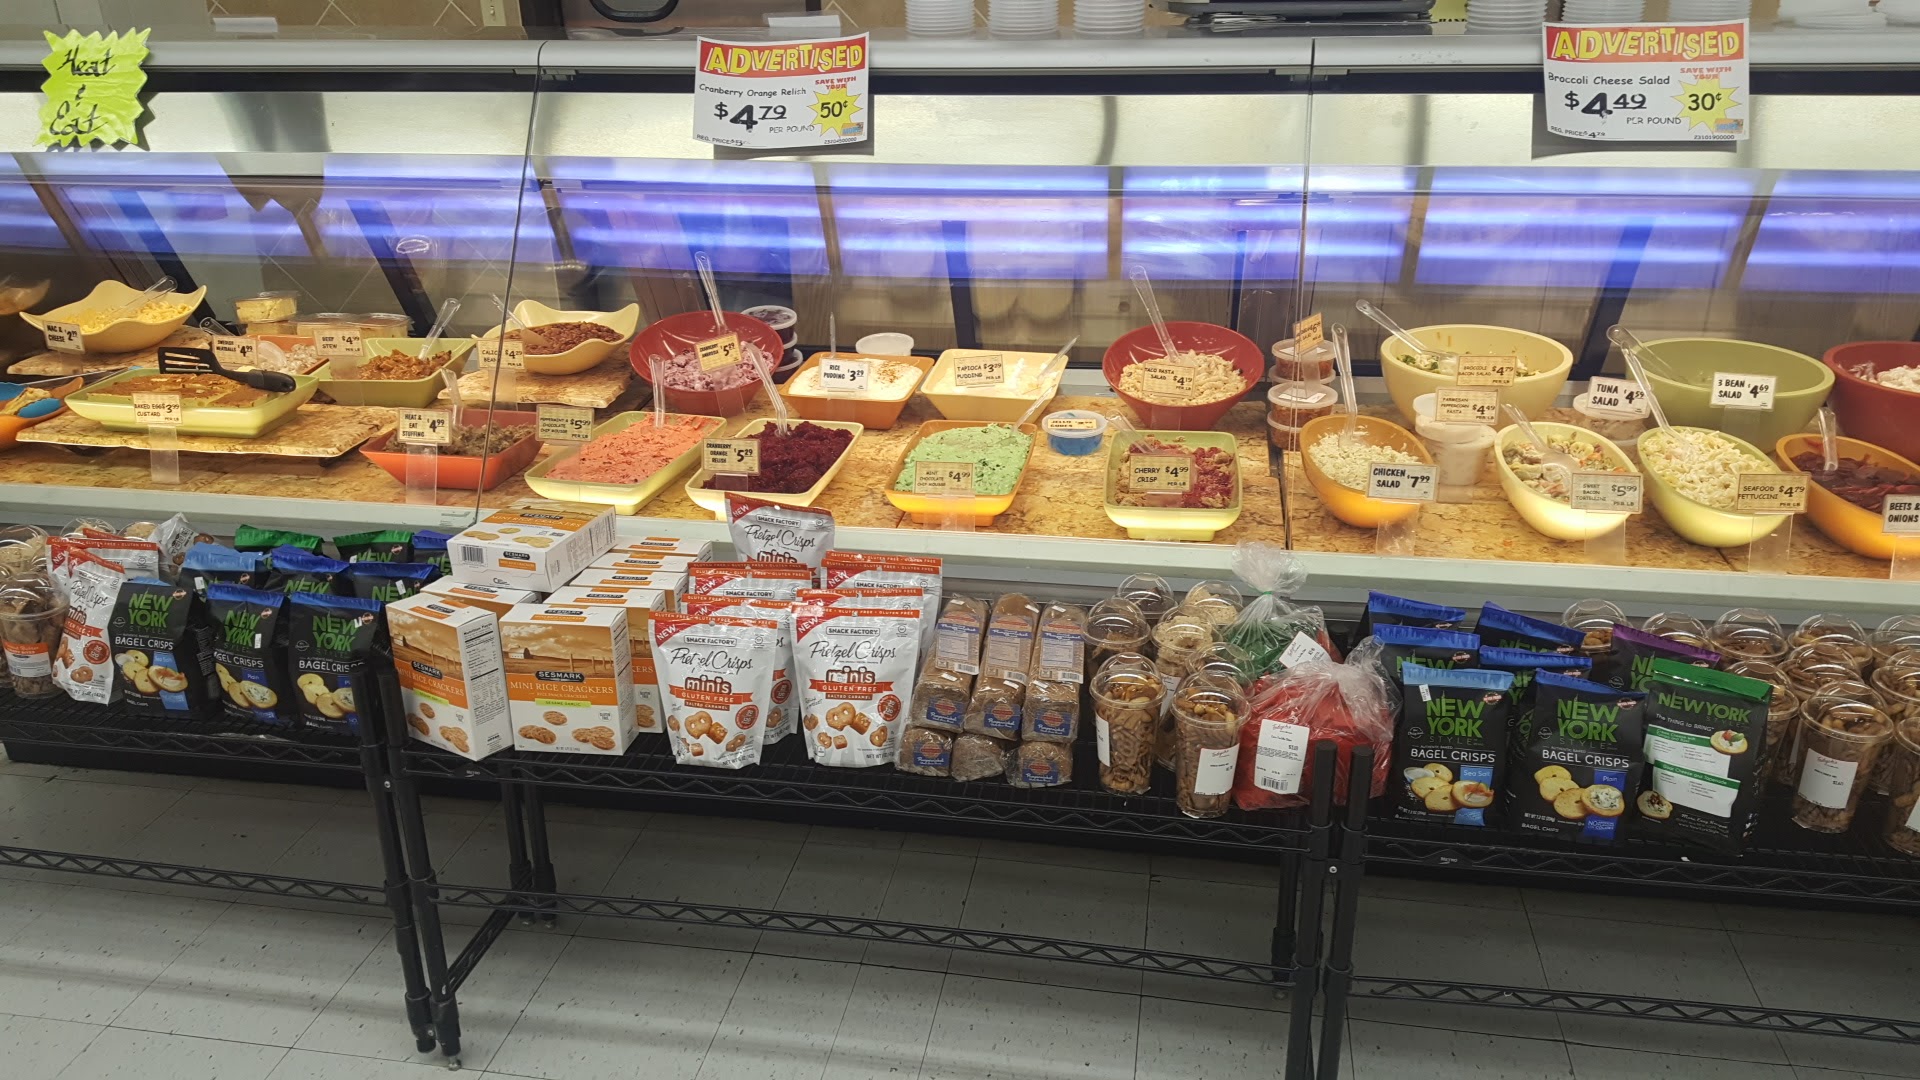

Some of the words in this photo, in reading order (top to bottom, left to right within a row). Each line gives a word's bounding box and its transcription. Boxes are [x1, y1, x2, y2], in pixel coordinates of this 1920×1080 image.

[1551, 27, 1740, 60] ADVERTISED
[57, 45, 118, 77] Heat
[705, 44, 864, 74] ADVERTISED
[1708, 66, 1732, 74] WITH
[1548, 72, 1589, 85] Broccoli
[1594, 75, 1635, 85] Cheese
[1639, 75, 1671, 85] Salad
[699, 84, 743, 98] Cranberry
[747, 89, 777, 98] Orange
[782, 86, 806, 96] Relish
[820, 100, 848, 118] 50¢
[1688, 92, 1722, 111] 30¢
[49, 101, 108, 136] Eat
[1626, 116, 1643, 124] PER
[1647, 116, 1682, 125] POUND
[769, 125, 786, 133] PER
[788, 124, 816, 133] POUND
[46, 324, 57, 332] MAC
[48, 334, 65, 343] CHEESE
[700, 343, 719, 352] CRANBERRY
[1597, 383, 1619, 394] TUNA
[1725, 380, 1745, 388] BEAN
[1592, 396, 1619, 406] SALAD
[1718, 390, 1742, 399] SALAD
[402, 430, 425, 438] STUFFING
[1373, 468, 1406, 477] CHICKEN
[1376, 480, 1400, 488] SALAD
[733, 504, 750, 517] NEW
[1889, 502, 1912, 511] BEETS
[1914, 502, 1920, 511] &
[1888, 514, 1919, 523] ONIONS
[744, 524, 781, 544] Pretzel
[830, 571, 849, 588] NEW
[697, 581, 717, 596] NEW
[129, 588, 173, 611] NEW
[129, 609, 168, 628] YORK
[224, 609, 261, 630] NEW
[312, 612, 358, 635] NEW
[799, 616, 819, 633] NEW
[224, 626, 255, 647] YORK
[657, 624, 677, 640] NEW
[115, 636, 146, 647] BAGEL
[147, 639, 174, 650] CRISPS
[313, 634, 356, 652] YORK
[809, 641, 854, 666] Pretzel
[233, 656, 264, 668] CRISPS
[299, 660, 330, 671] BAGEL
[412, 661, 441, 677] SESMARK
[538, 671, 582, 680] SESMARK
[413, 672, 427, 684] RICE
[428, 678, 464, 697] CRACKERS
[511, 681, 533, 690] MINI
[536, 683, 558, 692] RICE
[559, 684, 614, 695] CRACKERS
[686, 674, 731, 693] minis
[682, 692, 711, 700] GLUTEN
[1426, 691, 1485, 719] NEW
[1558, 694, 1619, 722] NEW
[1658, 690, 1707, 714] NEW
[1706, 703, 1751, 723] YORK
[1426, 717, 1483, 738] YORK
[1557, 719, 1618, 742] YORK
[1410, 748, 1447, 759] BAGEL
[1450, 750, 1496, 763] CRISPS
[1542, 749, 1581, 763] BAGEL
[1585, 755, 1630, 768] CRISPS
[1477, 769, 1491, 777] Salt
